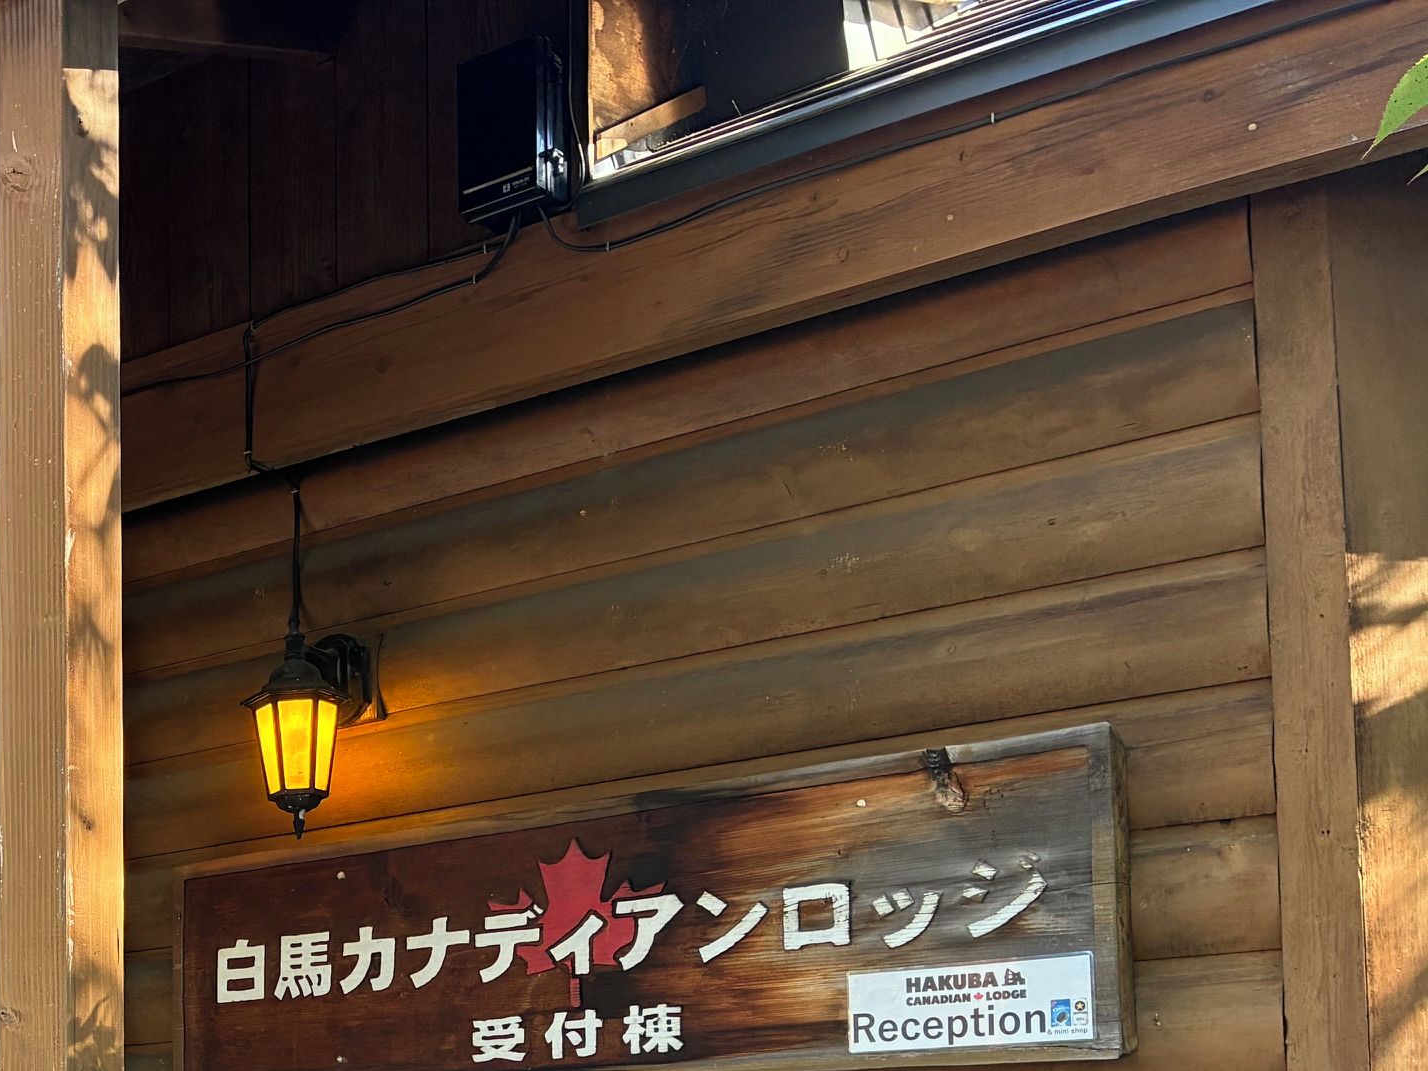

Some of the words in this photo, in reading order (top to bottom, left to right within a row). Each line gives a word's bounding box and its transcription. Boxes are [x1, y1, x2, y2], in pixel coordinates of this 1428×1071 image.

[217, 851, 1049, 1004] 白馬カナディアンロッジ
[905, 970, 999, 994] HAKUBA
[905, 992, 972, 1007] CANADIAN
[985, 989, 1028, 1002] LODGE
[471, 1003, 685, 1063] 受付棟
[853, 1004, 1047, 1046] Reception
